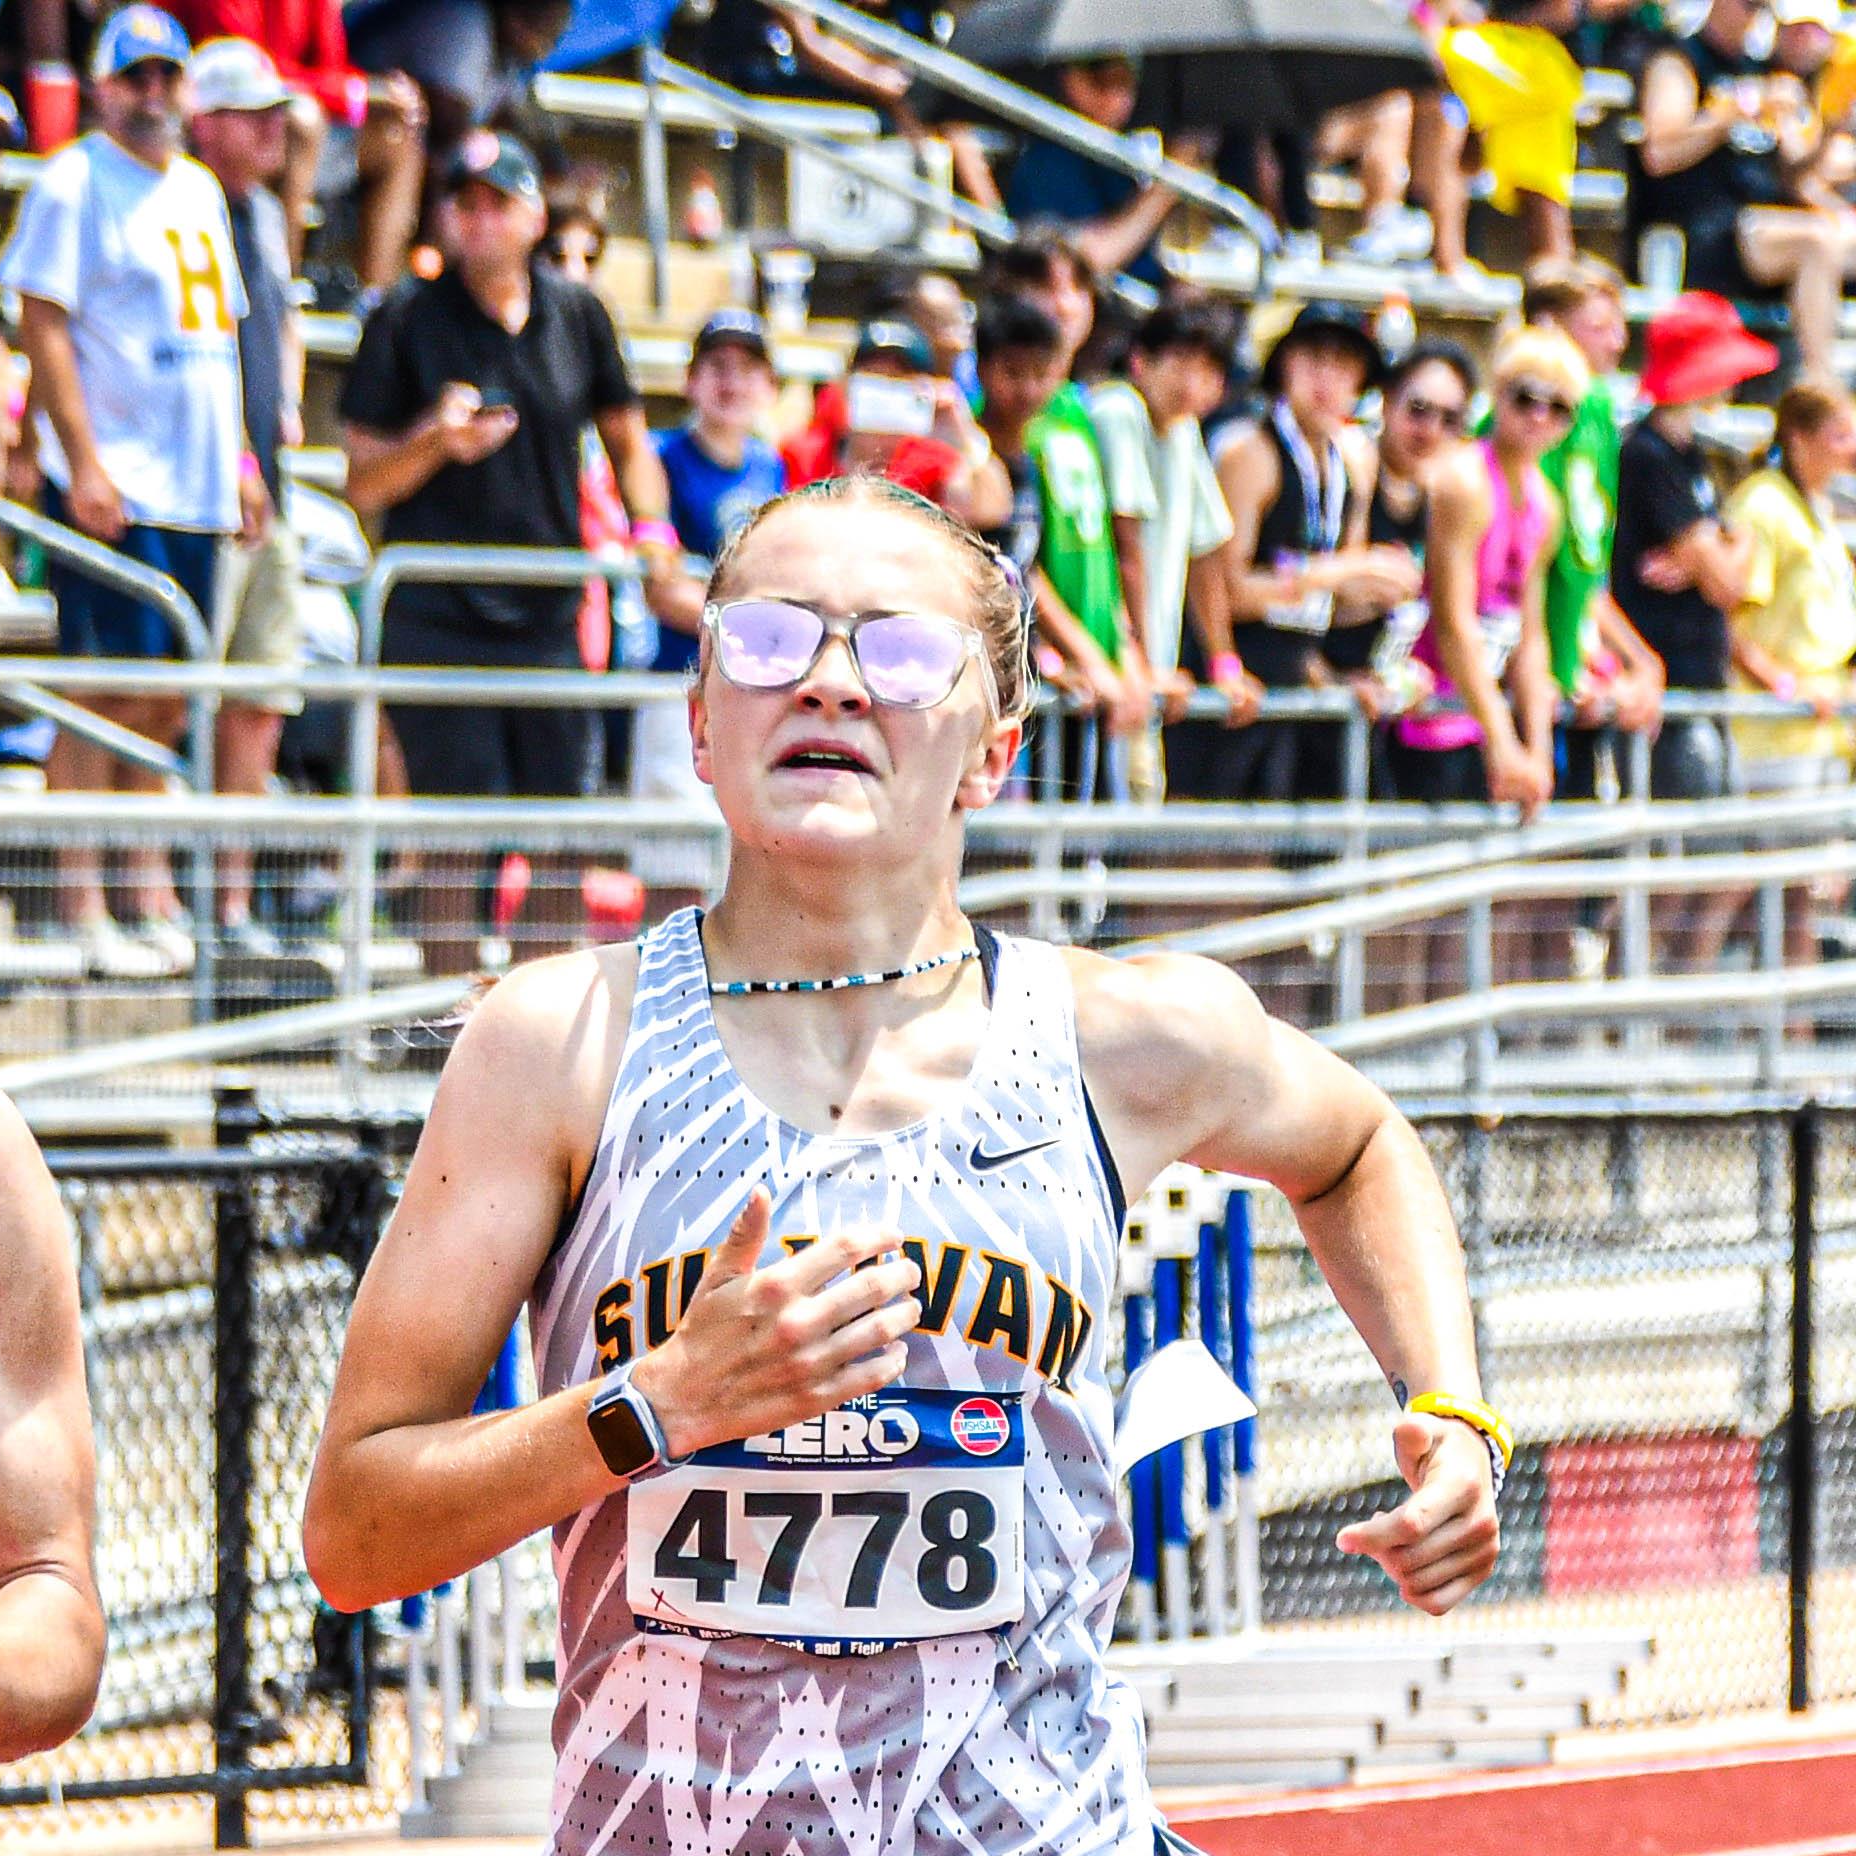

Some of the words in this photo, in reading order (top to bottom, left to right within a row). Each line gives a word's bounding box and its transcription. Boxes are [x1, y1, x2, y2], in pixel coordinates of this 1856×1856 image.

[163, 228, 237, 335] H
[593, 1234, 1096, 1397] SUVAN
[960, 1420, 999, 1434] MSHSAA
[653, 1488, 1000, 1612] 4778
[815, 1642, 841, 1656] and
[850, 1641, 885, 1656] Field
